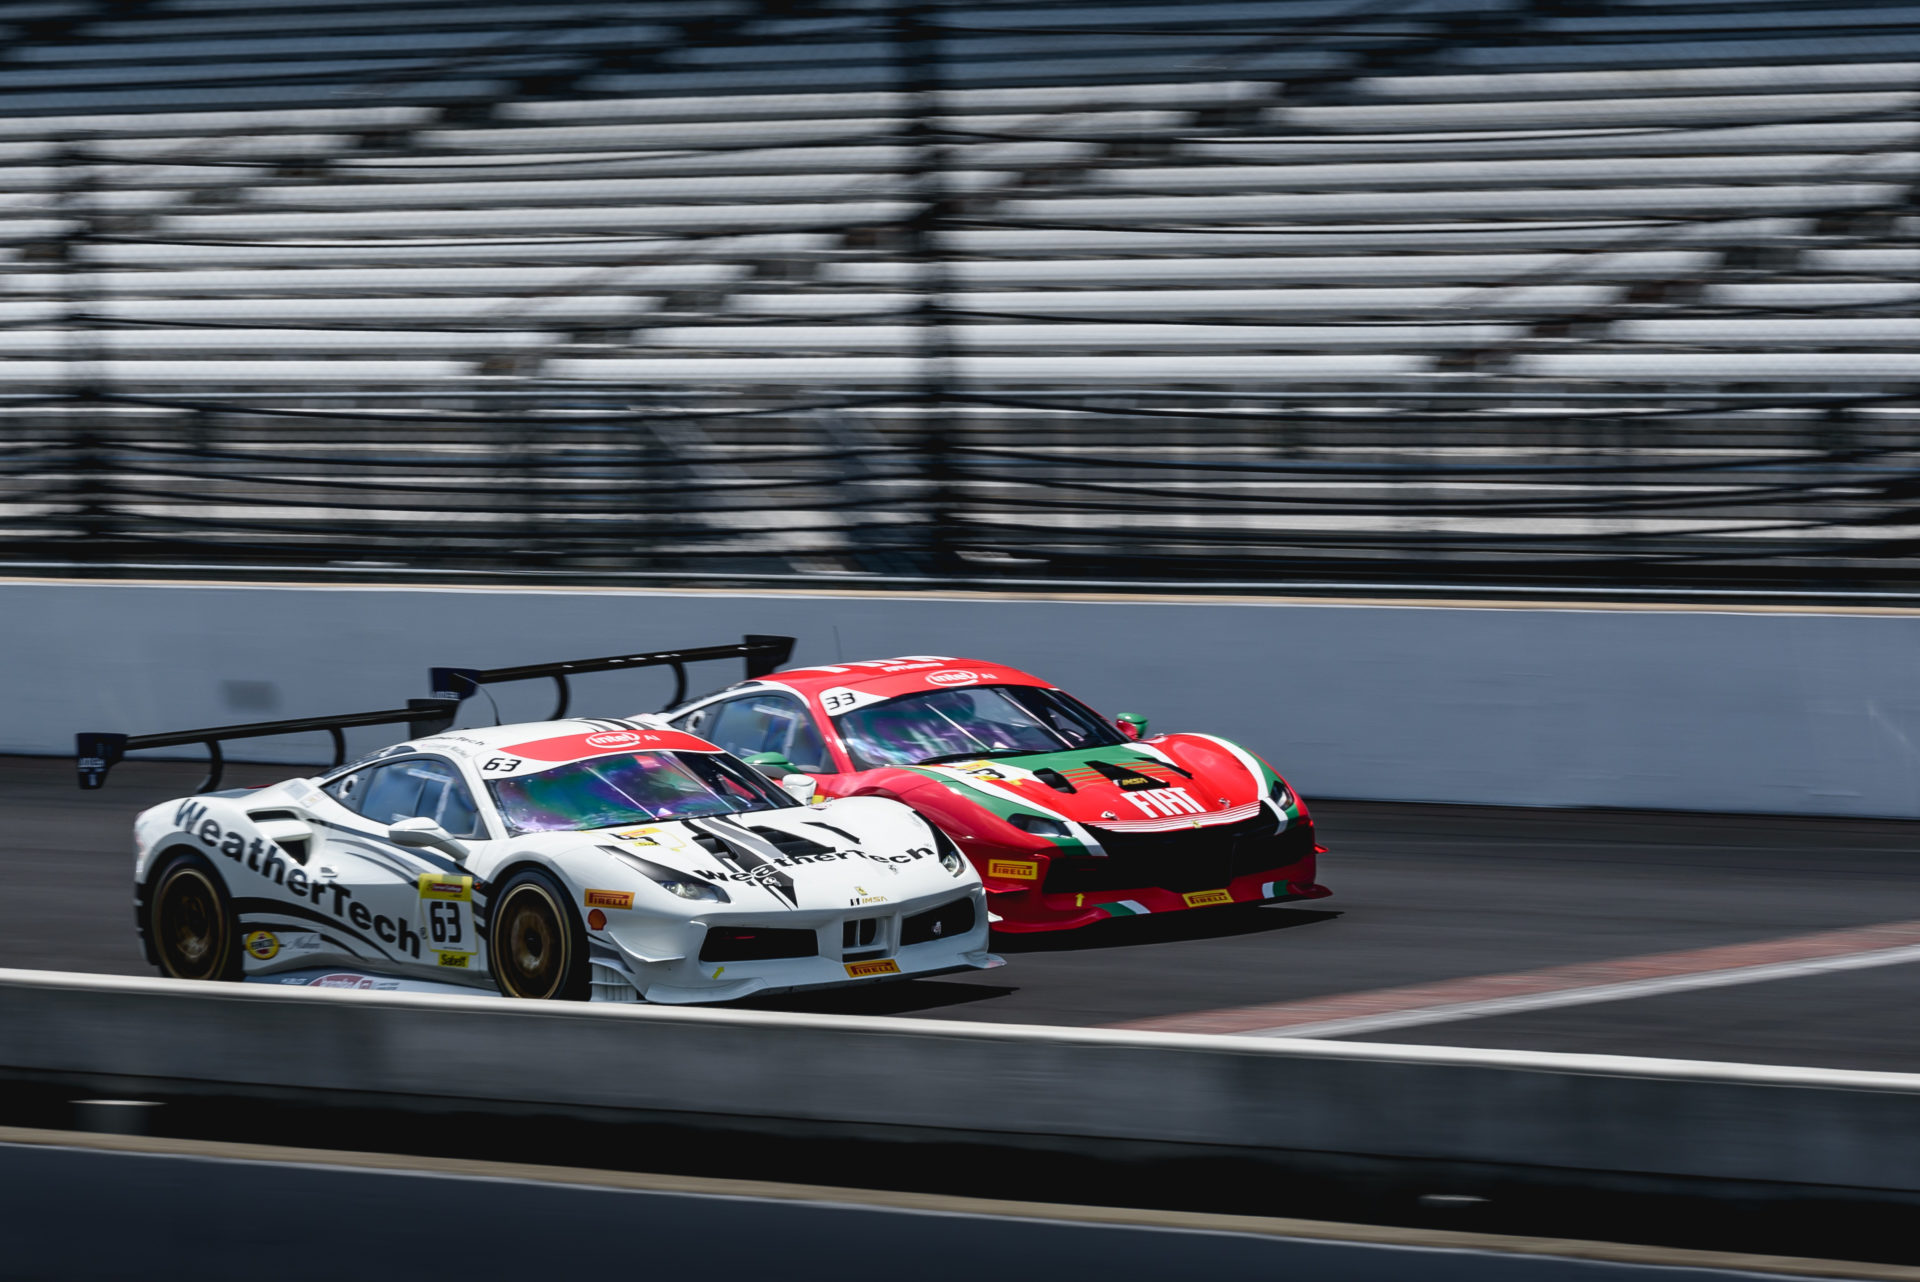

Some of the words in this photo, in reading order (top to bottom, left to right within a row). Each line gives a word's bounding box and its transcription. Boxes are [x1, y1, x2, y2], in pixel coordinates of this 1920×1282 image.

[826, 692, 856, 710] 33
[590, 733, 635, 745] intel
[483, 758, 521, 773] 63
[1119, 787, 1207, 819] FIAT
[992, 863, 1033, 876] PIRELLI
[174, 799, 421, 959] WeatherTech
[588, 892, 630, 906] PIRELLI
[1188, 892, 1228, 904] PIRELLI
[430, 901, 462, 943] 63
[850, 961, 895, 975] PIRELLI
